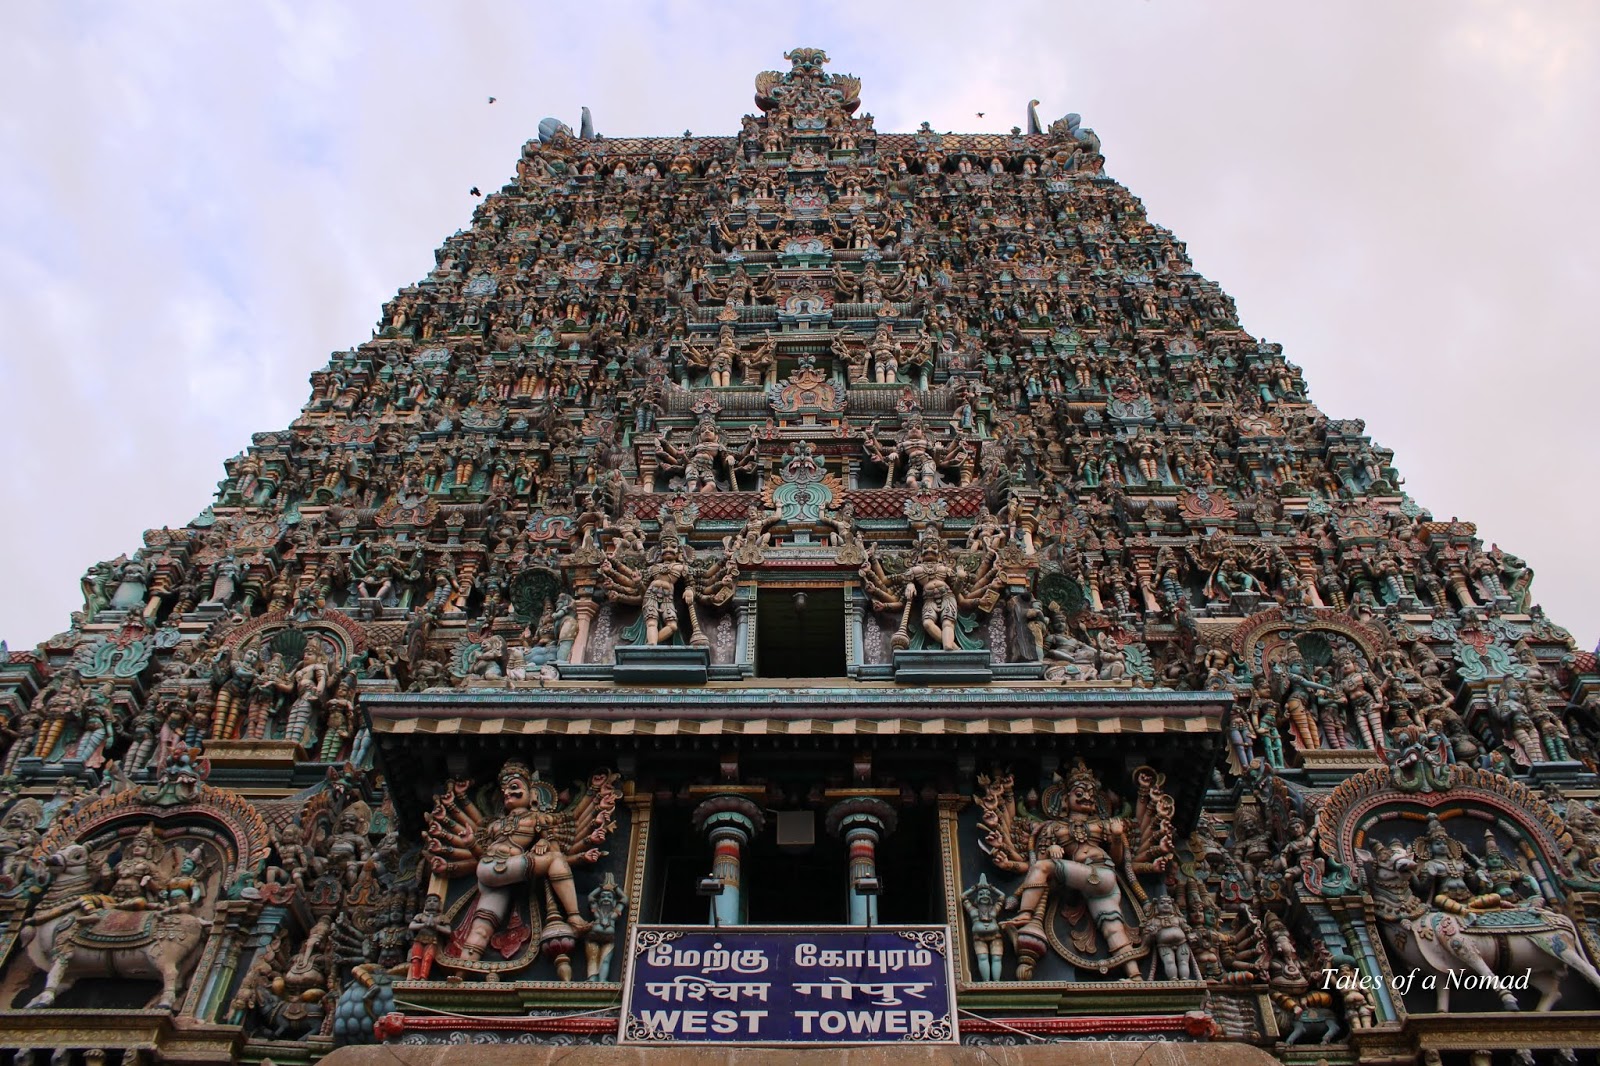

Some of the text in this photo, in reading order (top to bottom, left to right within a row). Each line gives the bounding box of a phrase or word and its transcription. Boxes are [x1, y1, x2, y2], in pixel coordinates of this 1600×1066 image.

[647, 942, 932, 974] மேற்கு கோபுரம்
[645, 975, 933, 1006] पश्चिम गोपुर
[641, 1010, 936, 1034] WEST TOWER
